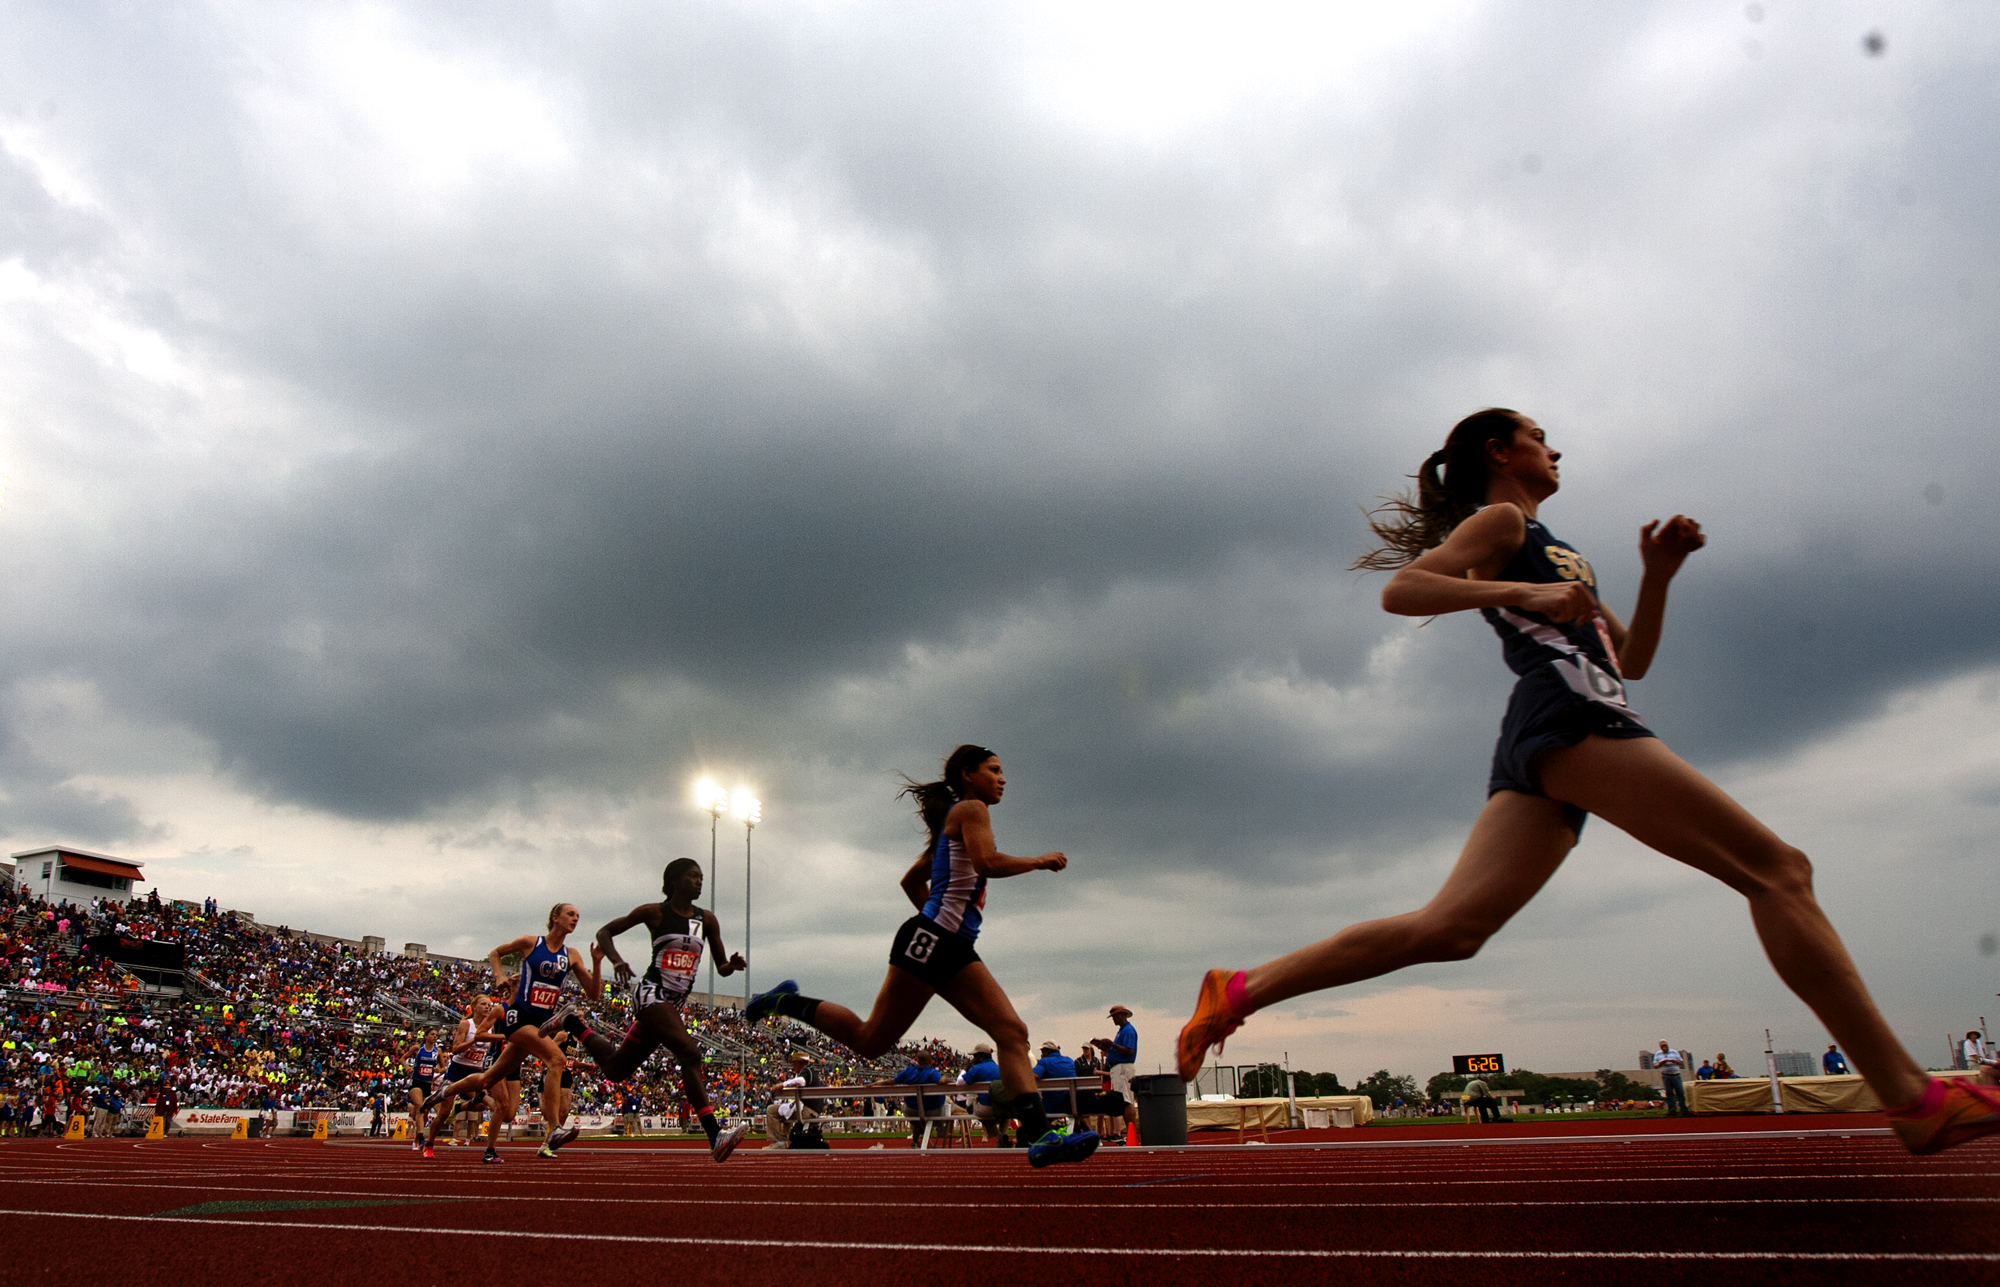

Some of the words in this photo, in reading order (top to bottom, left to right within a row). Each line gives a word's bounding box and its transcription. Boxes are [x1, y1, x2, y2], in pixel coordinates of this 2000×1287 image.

[690, 920, 701, 936] 7
[910, 932, 932, 959] 8
[559, 956, 567, 970] 6
[533, 990, 556, 1004] 1471
[642, 986, 653, 1003] 7
[80, 1001, 87, 1011] 4
[507, 1010, 515, 1025] 6
[1467, 1056, 1499, 1072] 6:26
[72, 1121, 79, 1131] 8
[153, 1122, 159, 1131] 7
[236, 1123, 242, 1132] 6
[318, 1124, 324, 1133] 5
[397, 1125, 402, 1133] 4
